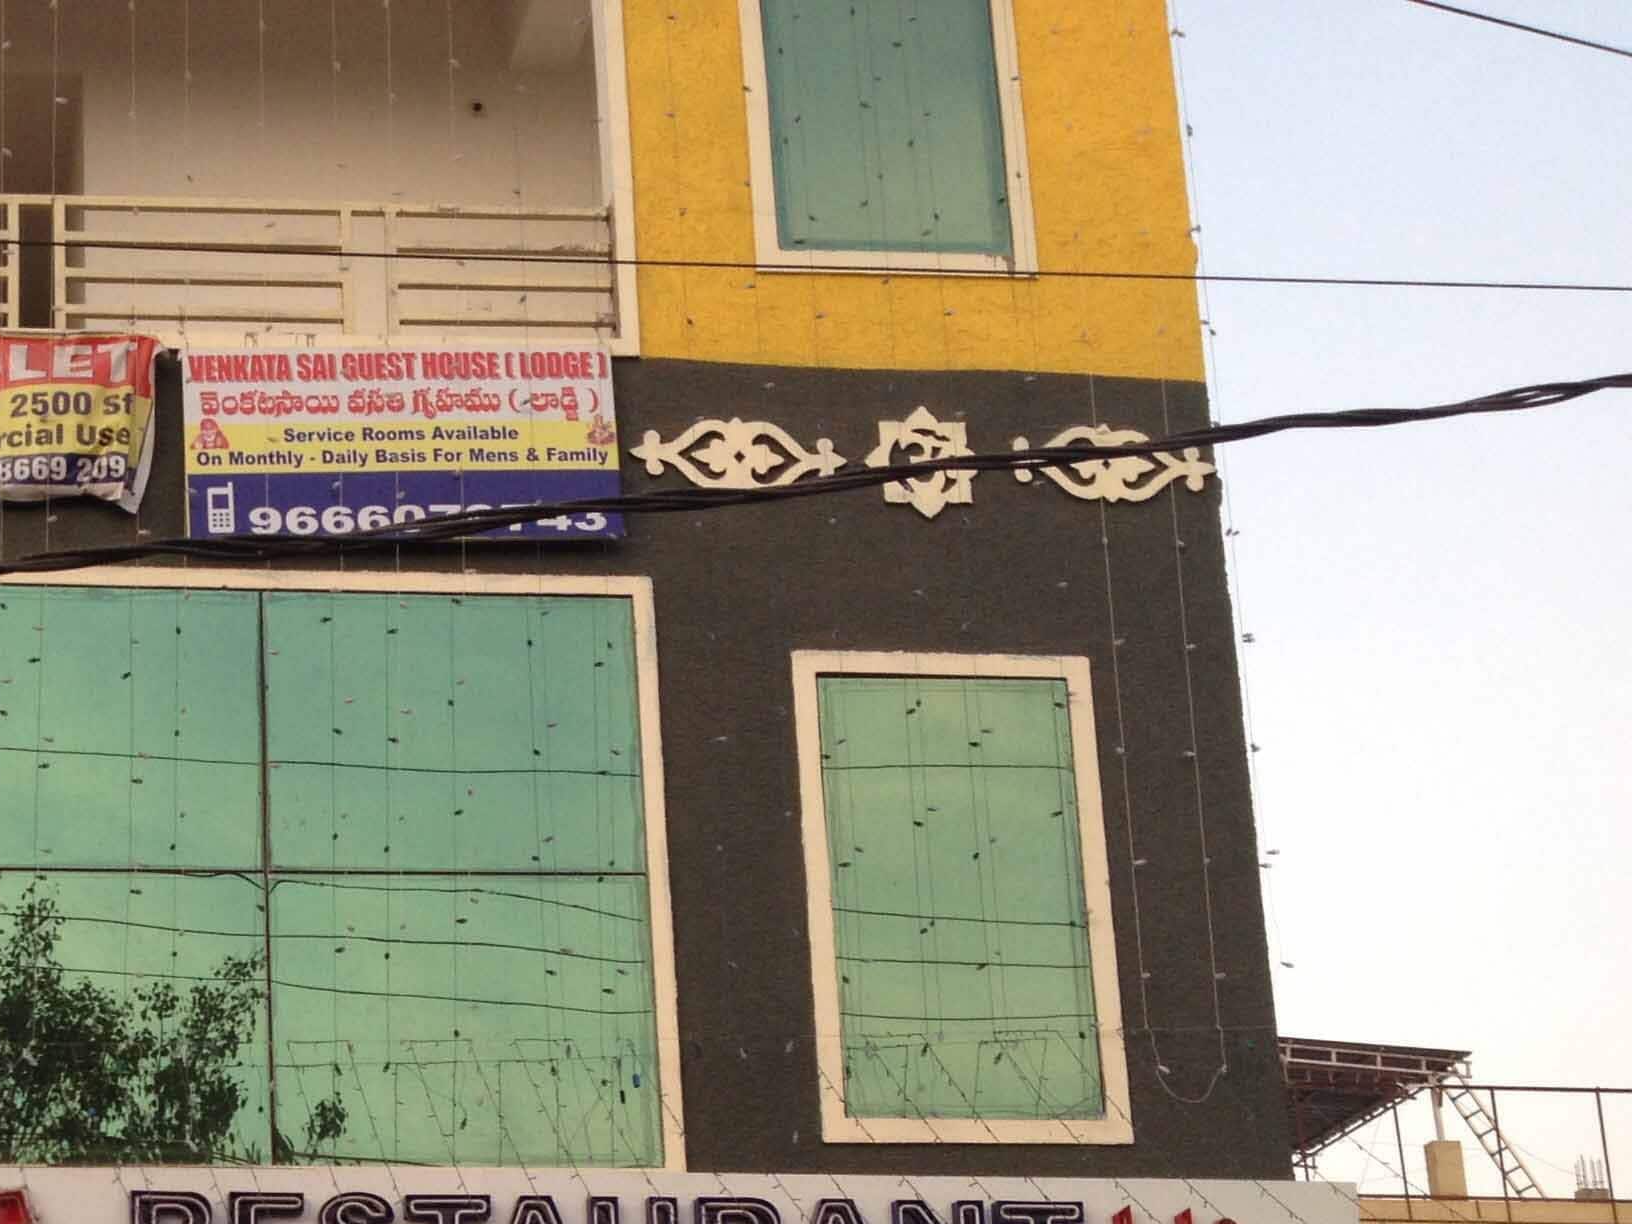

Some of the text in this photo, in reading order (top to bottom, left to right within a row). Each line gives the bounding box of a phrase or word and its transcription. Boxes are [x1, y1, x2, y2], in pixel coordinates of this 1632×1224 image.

[187, 353, 293, 383] VENKATA
[296, 352, 337, 382] SAI
[341, 351, 416, 382] GUEST
[421, 351, 502, 381] HOUSE
[519, 351, 594, 379] LODGE
[10, 390, 93, 418] 2500
[76, 423, 131, 447] Use
[283, 425, 519, 443] Service Rooms Available
[196, 451, 223, 466] On
[229, 450, 304, 469] Monthly
[321, 449, 369, 468] Daily
[376, 448, 427, 464] Basis
[433, 448, 464, 463] For
[469, 447, 519, 463] Mens
[525, 447, 540, 462] &
[546, 446, 609, 466] Family
